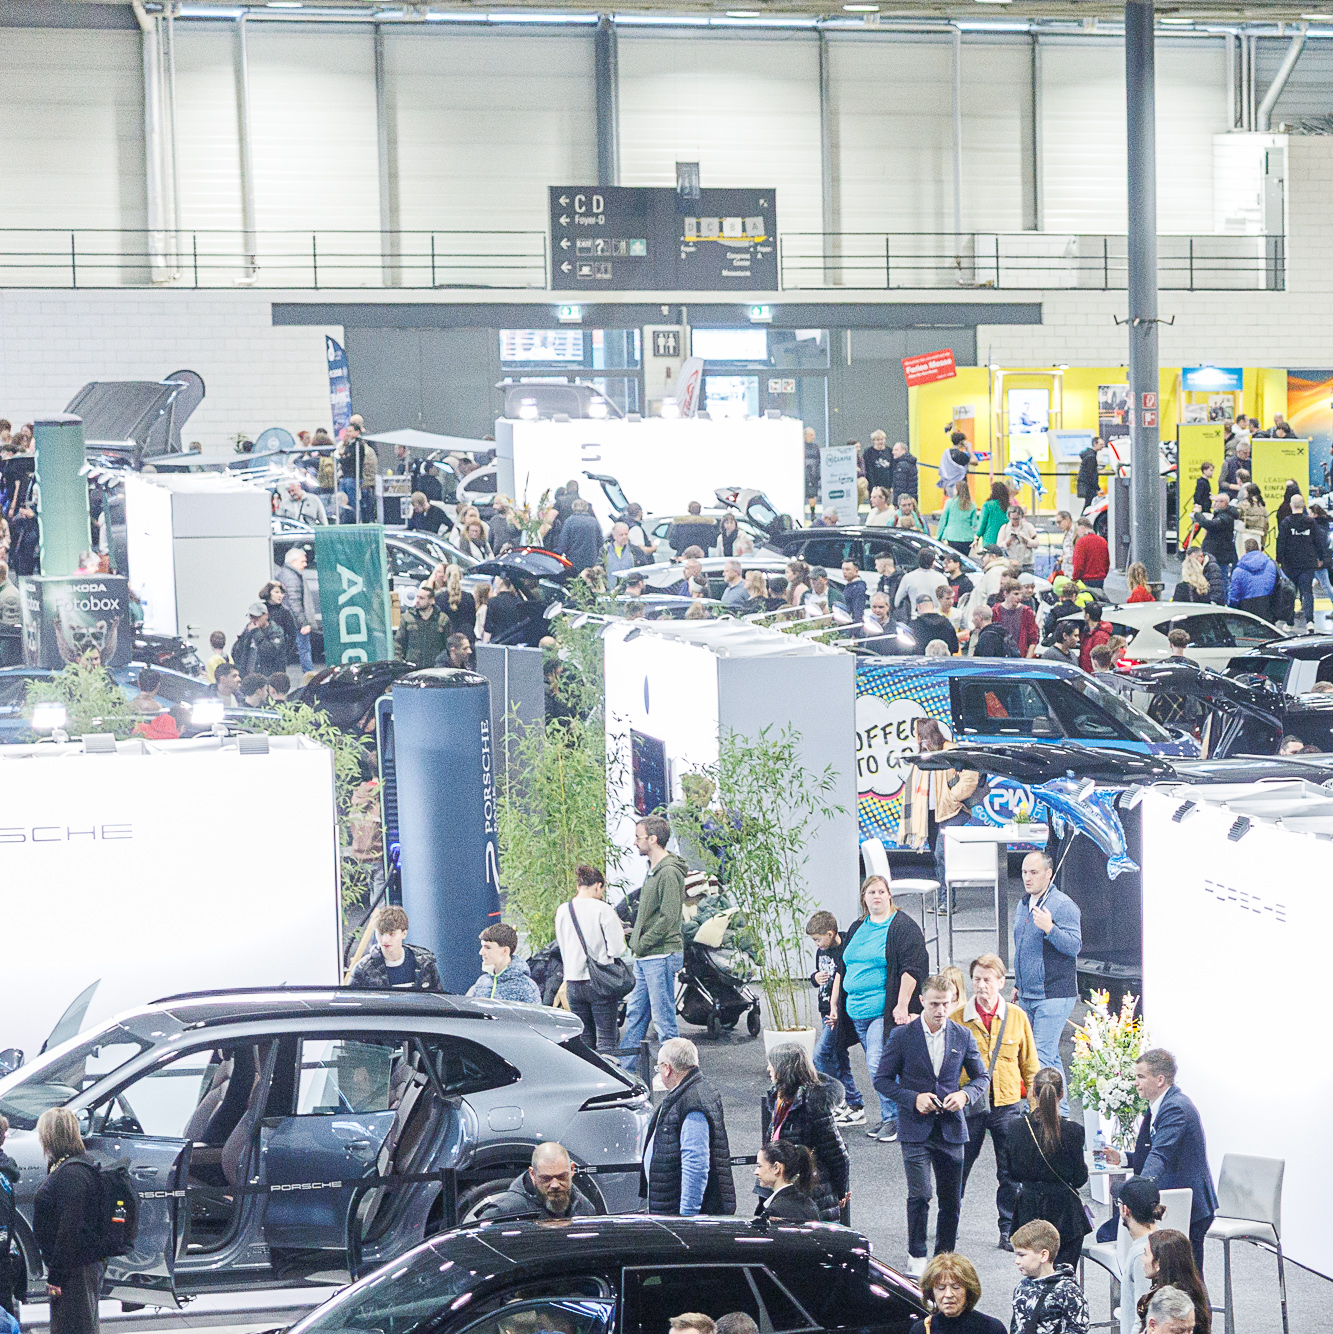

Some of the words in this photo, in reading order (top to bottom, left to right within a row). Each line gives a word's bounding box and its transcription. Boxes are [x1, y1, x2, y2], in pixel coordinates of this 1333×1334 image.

[574, 194, 587, 213] C
[592, 194, 605, 213] D
[54, 594, 121, 611] Fotobox
[480, 719, 493, 834] PORSCHE
[270, 1181, 342, 1192] PORSCHE
